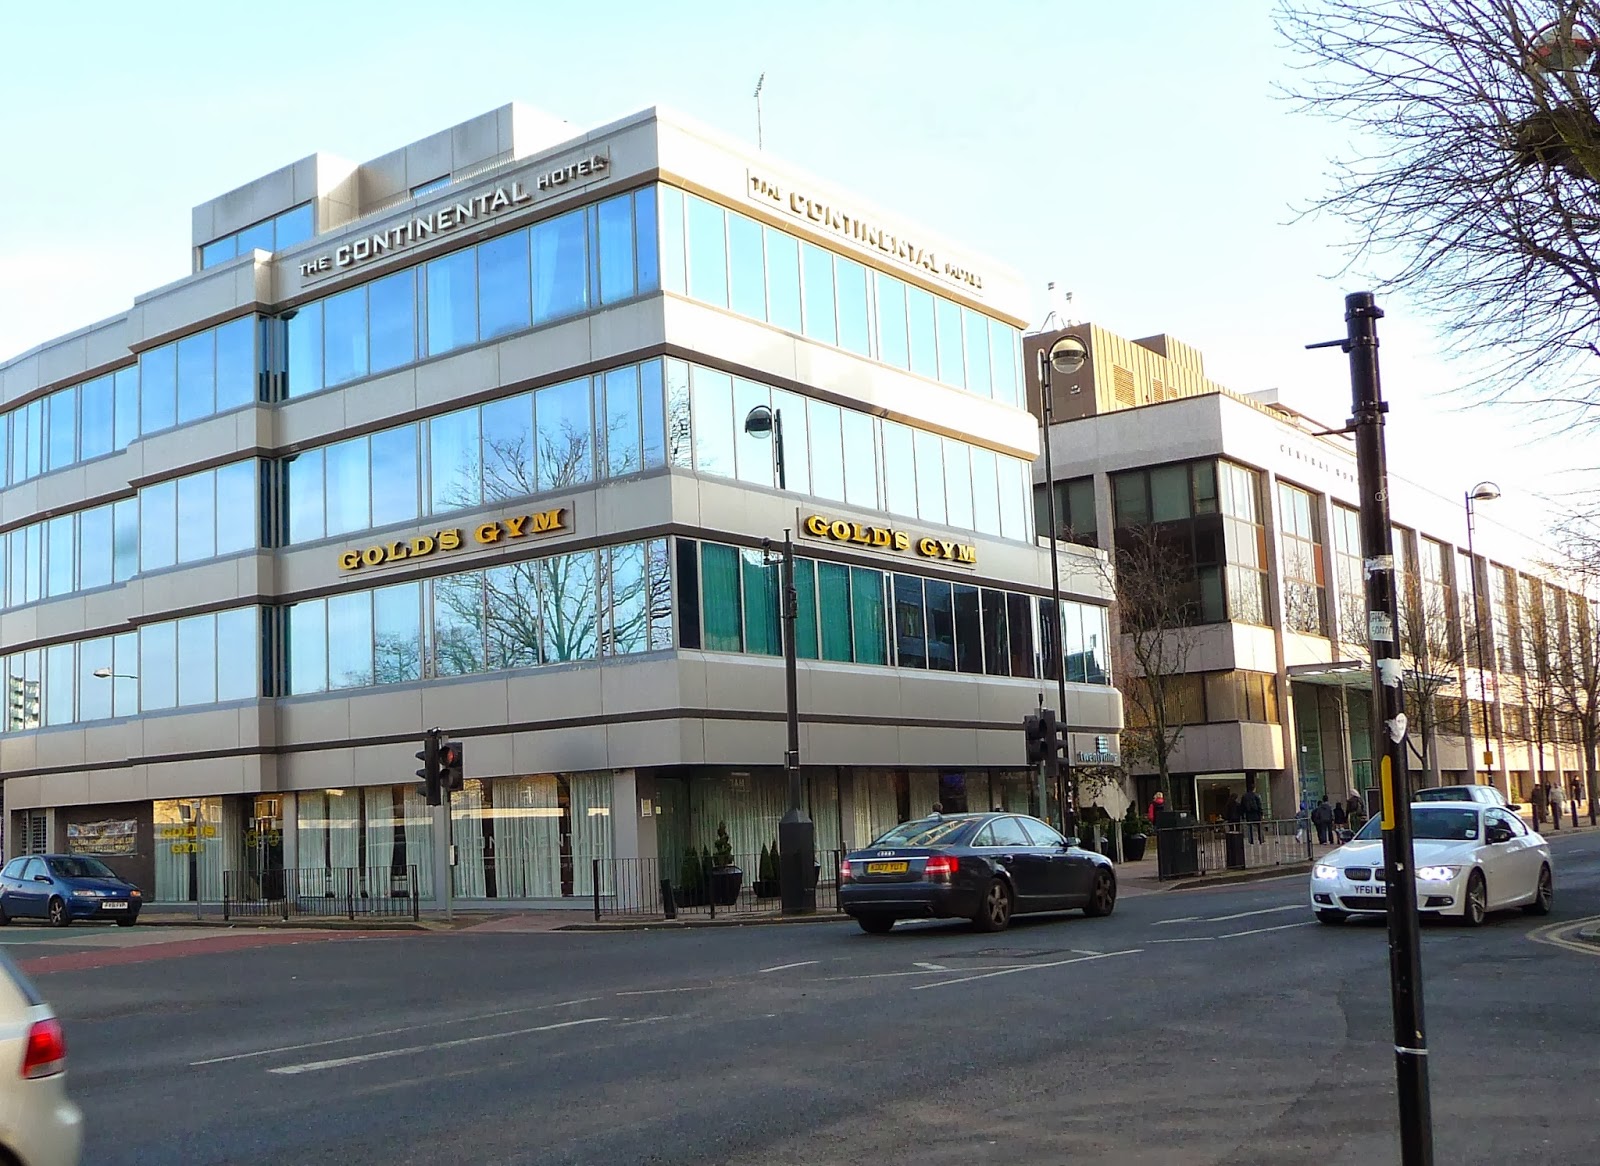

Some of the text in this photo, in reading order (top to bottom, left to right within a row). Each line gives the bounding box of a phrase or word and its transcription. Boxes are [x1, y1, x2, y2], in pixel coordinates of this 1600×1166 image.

[298, 154, 607, 277] THE CONTINENTAL HOTEL
[789, 191, 940, 274] CONTINENTAL
[337, 507, 566, 571] GOLD'S GYM
[804, 514, 977, 564] GOLD'S GYM
[1354, 885, 1387, 894] YF61 WE
